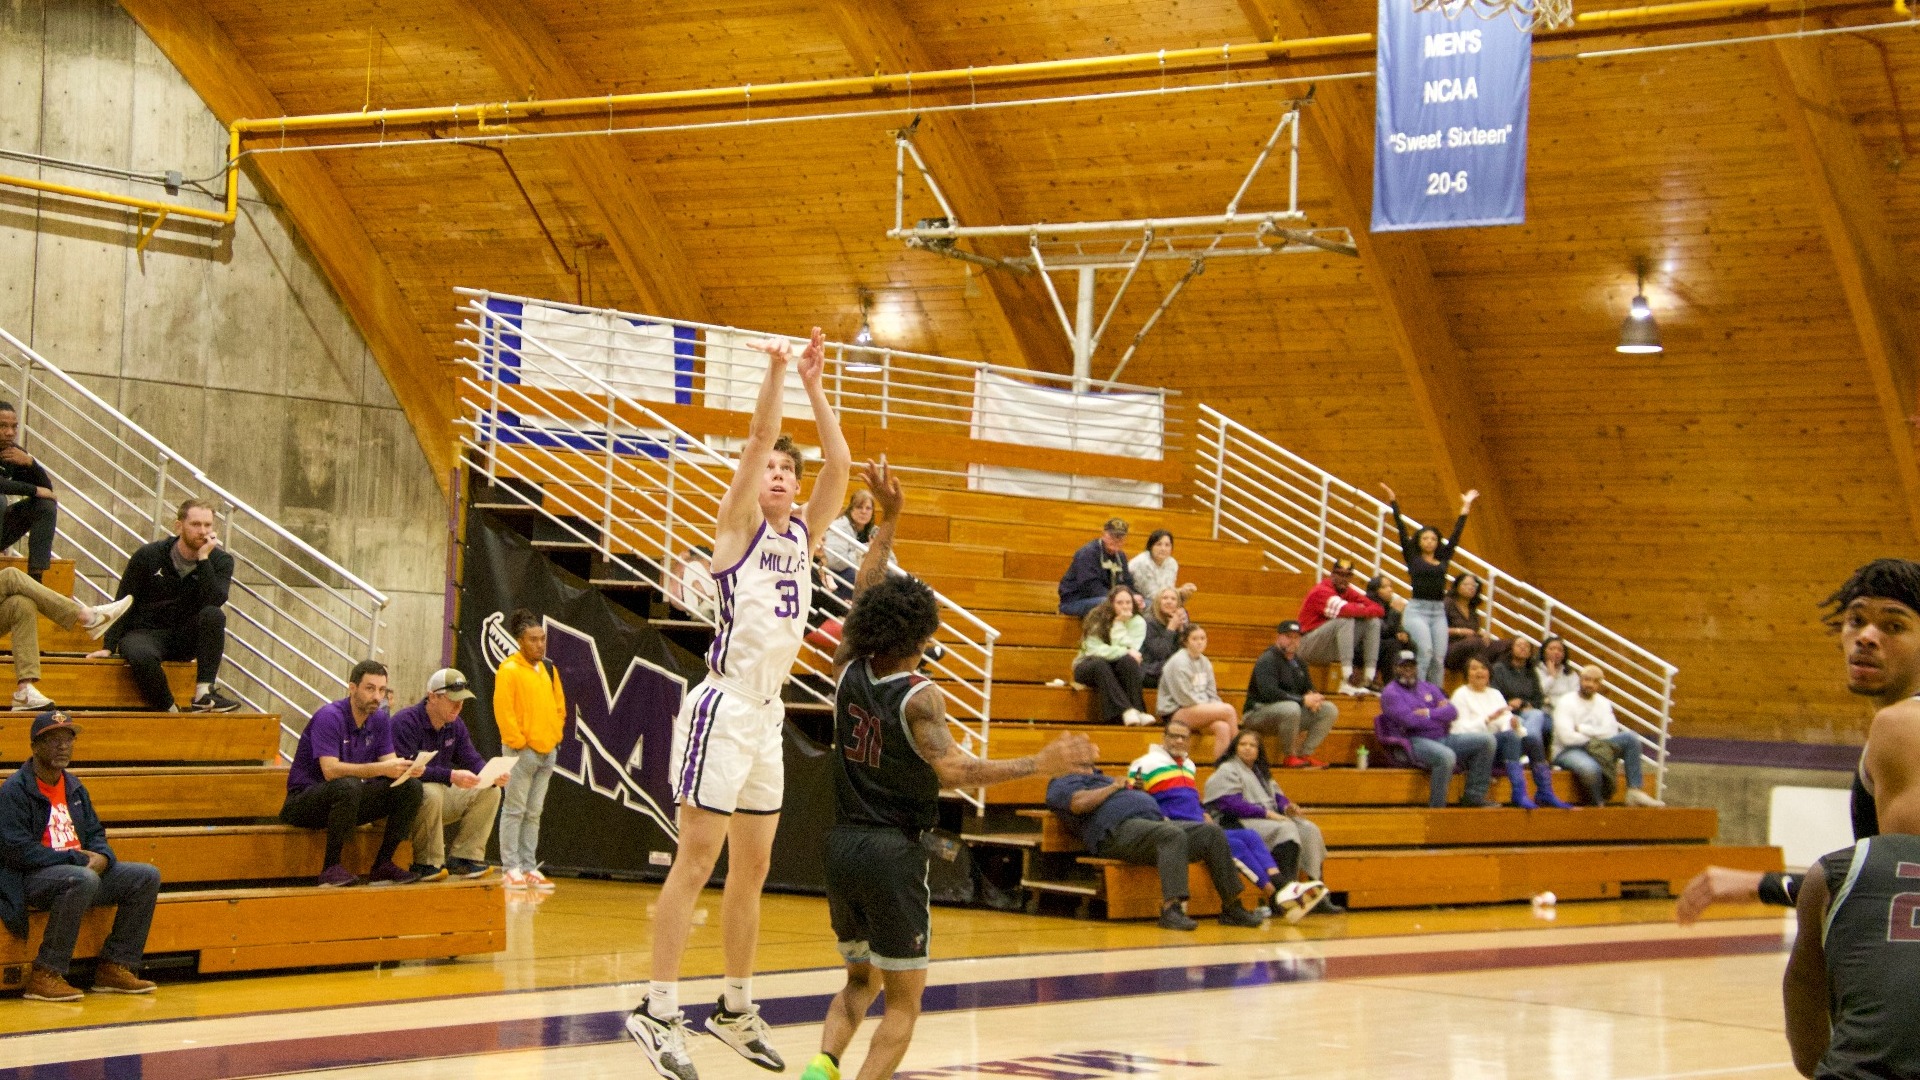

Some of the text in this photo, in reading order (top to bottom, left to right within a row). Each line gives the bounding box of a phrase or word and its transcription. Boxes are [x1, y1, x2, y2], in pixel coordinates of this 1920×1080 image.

[1424, 29, 1482, 58] MEN'S
[1423, 76, 1478, 104] NCAA
[1426, 170, 1468, 195] 20-6
